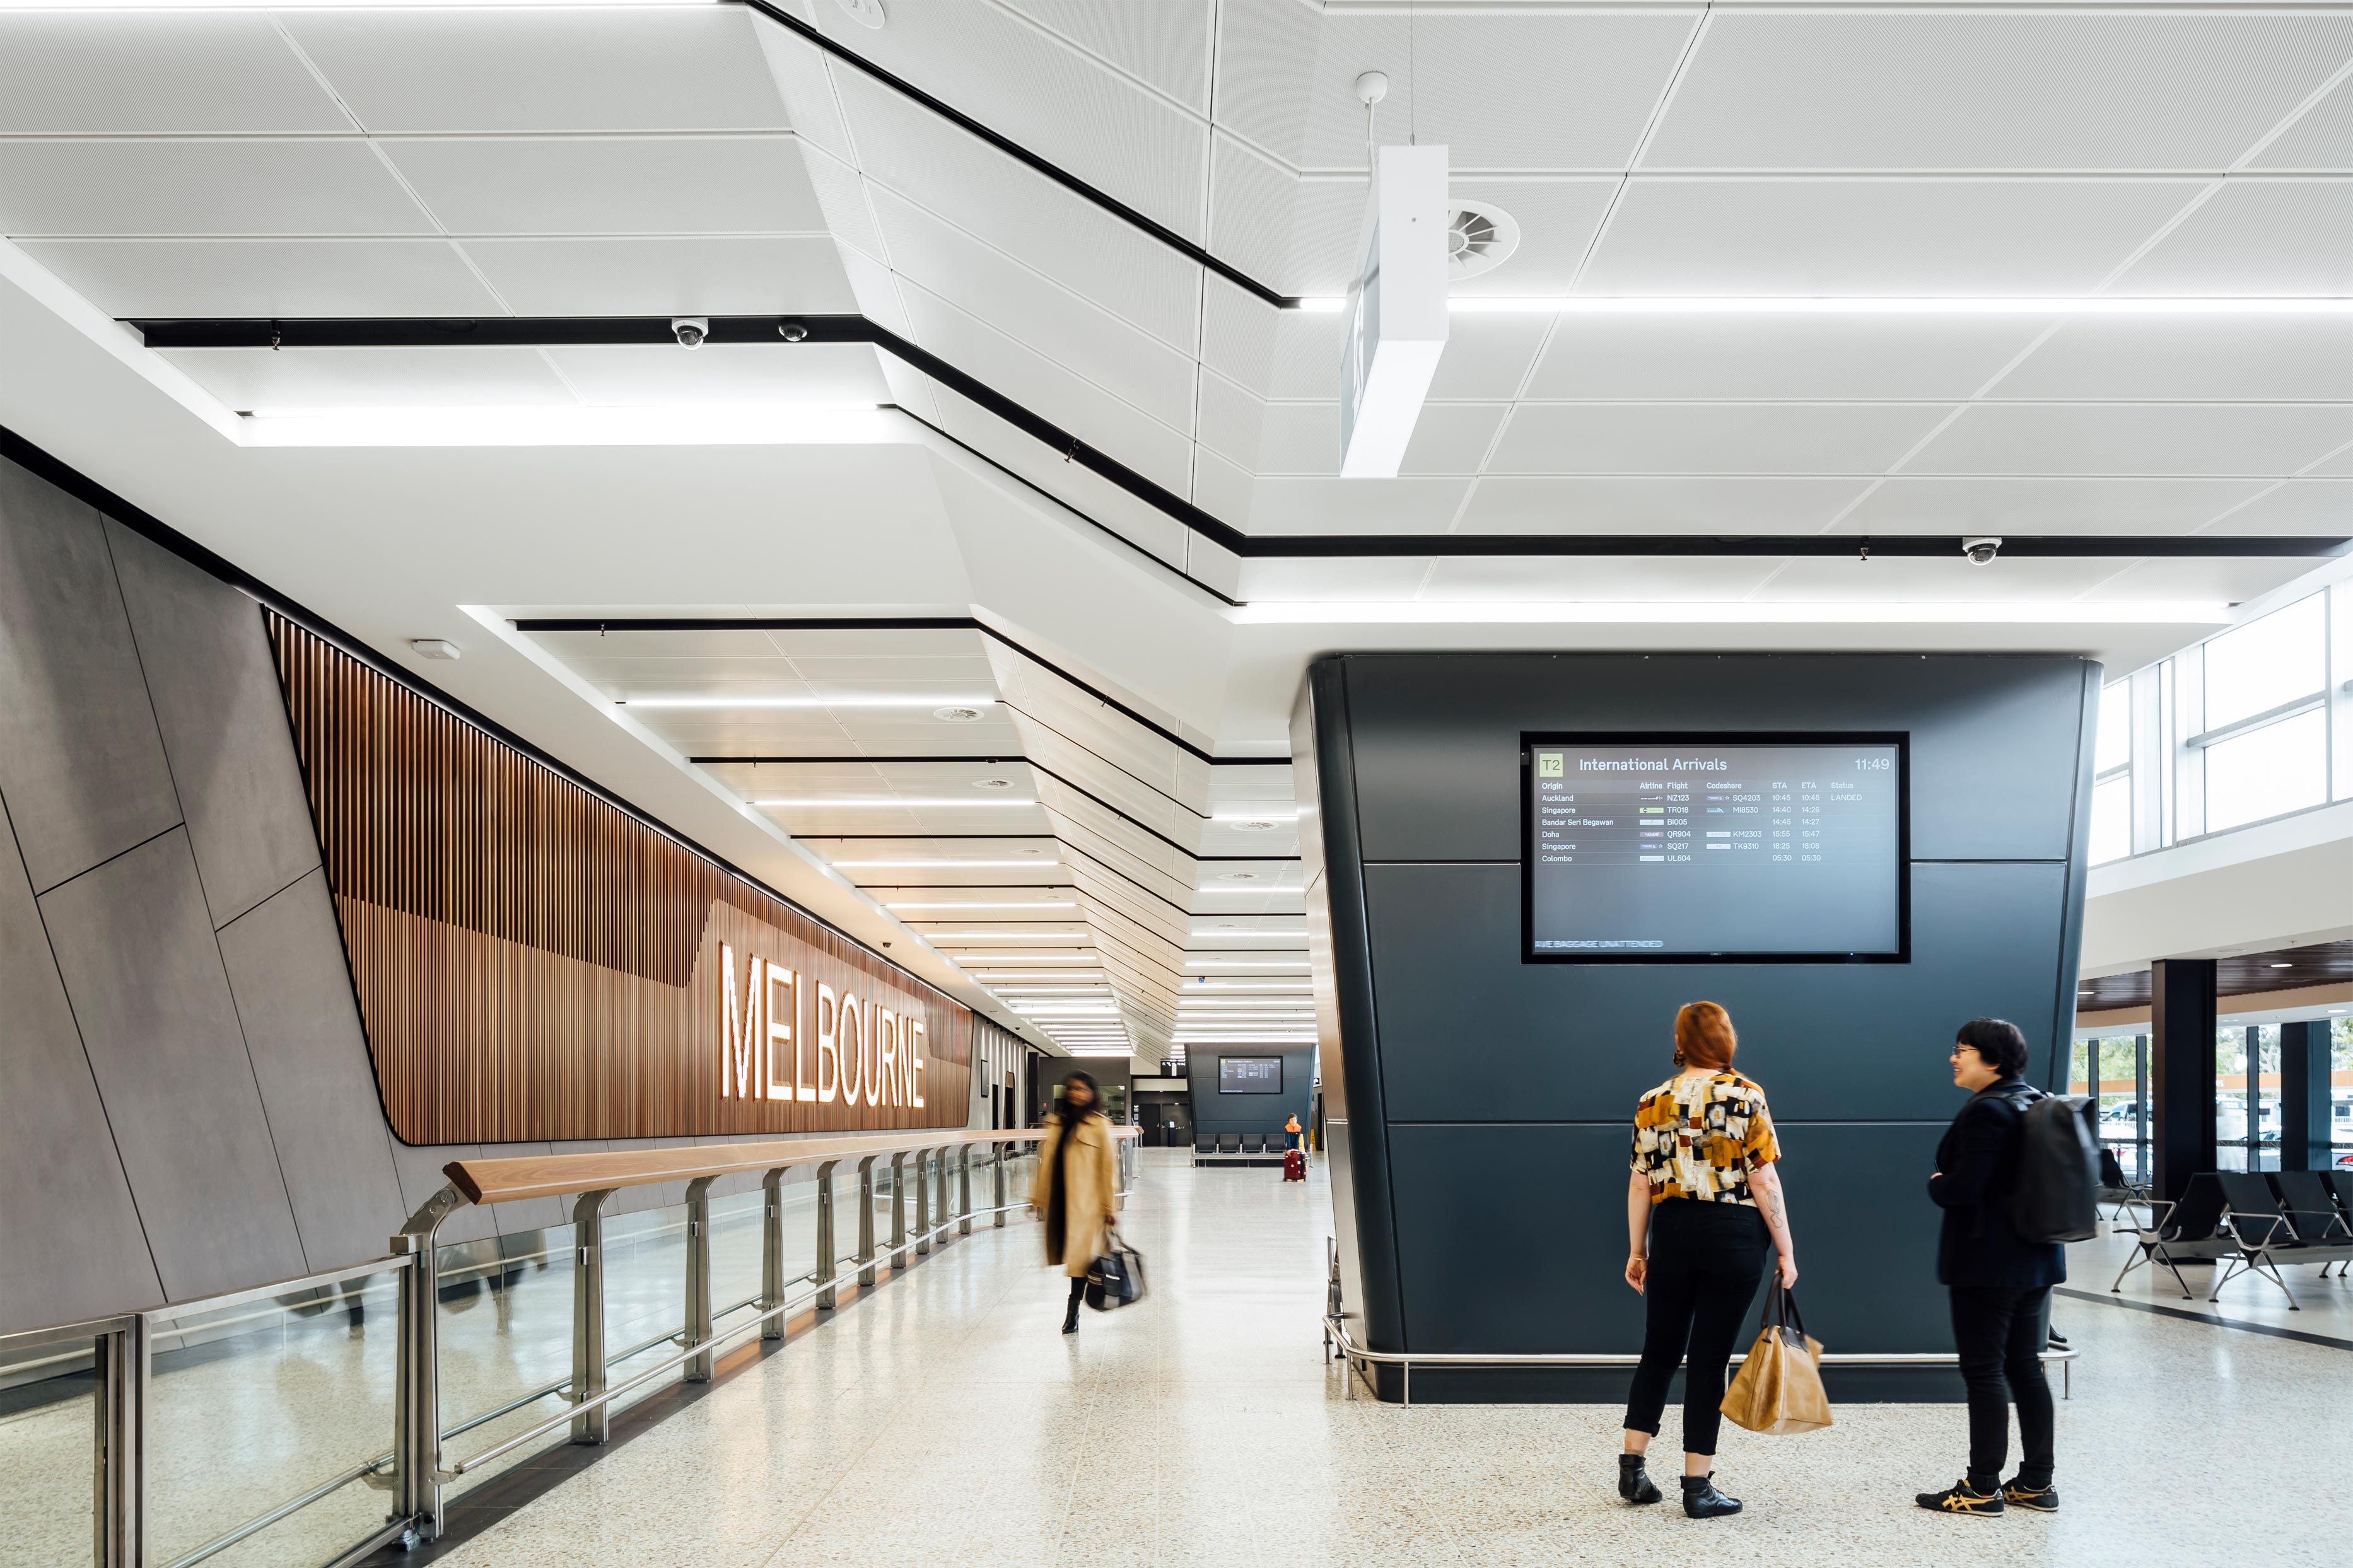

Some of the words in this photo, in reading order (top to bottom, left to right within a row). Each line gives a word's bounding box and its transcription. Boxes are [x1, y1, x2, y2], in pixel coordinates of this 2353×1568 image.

[1542, 760, 1560, 770] T2
[1580, 758, 1668, 770] International
[1673, 758, 1727, 770] Arrivals
[1855, 759, 1889, 770] 11:49
[721, 943, 924, 1108] MELBOURNE
